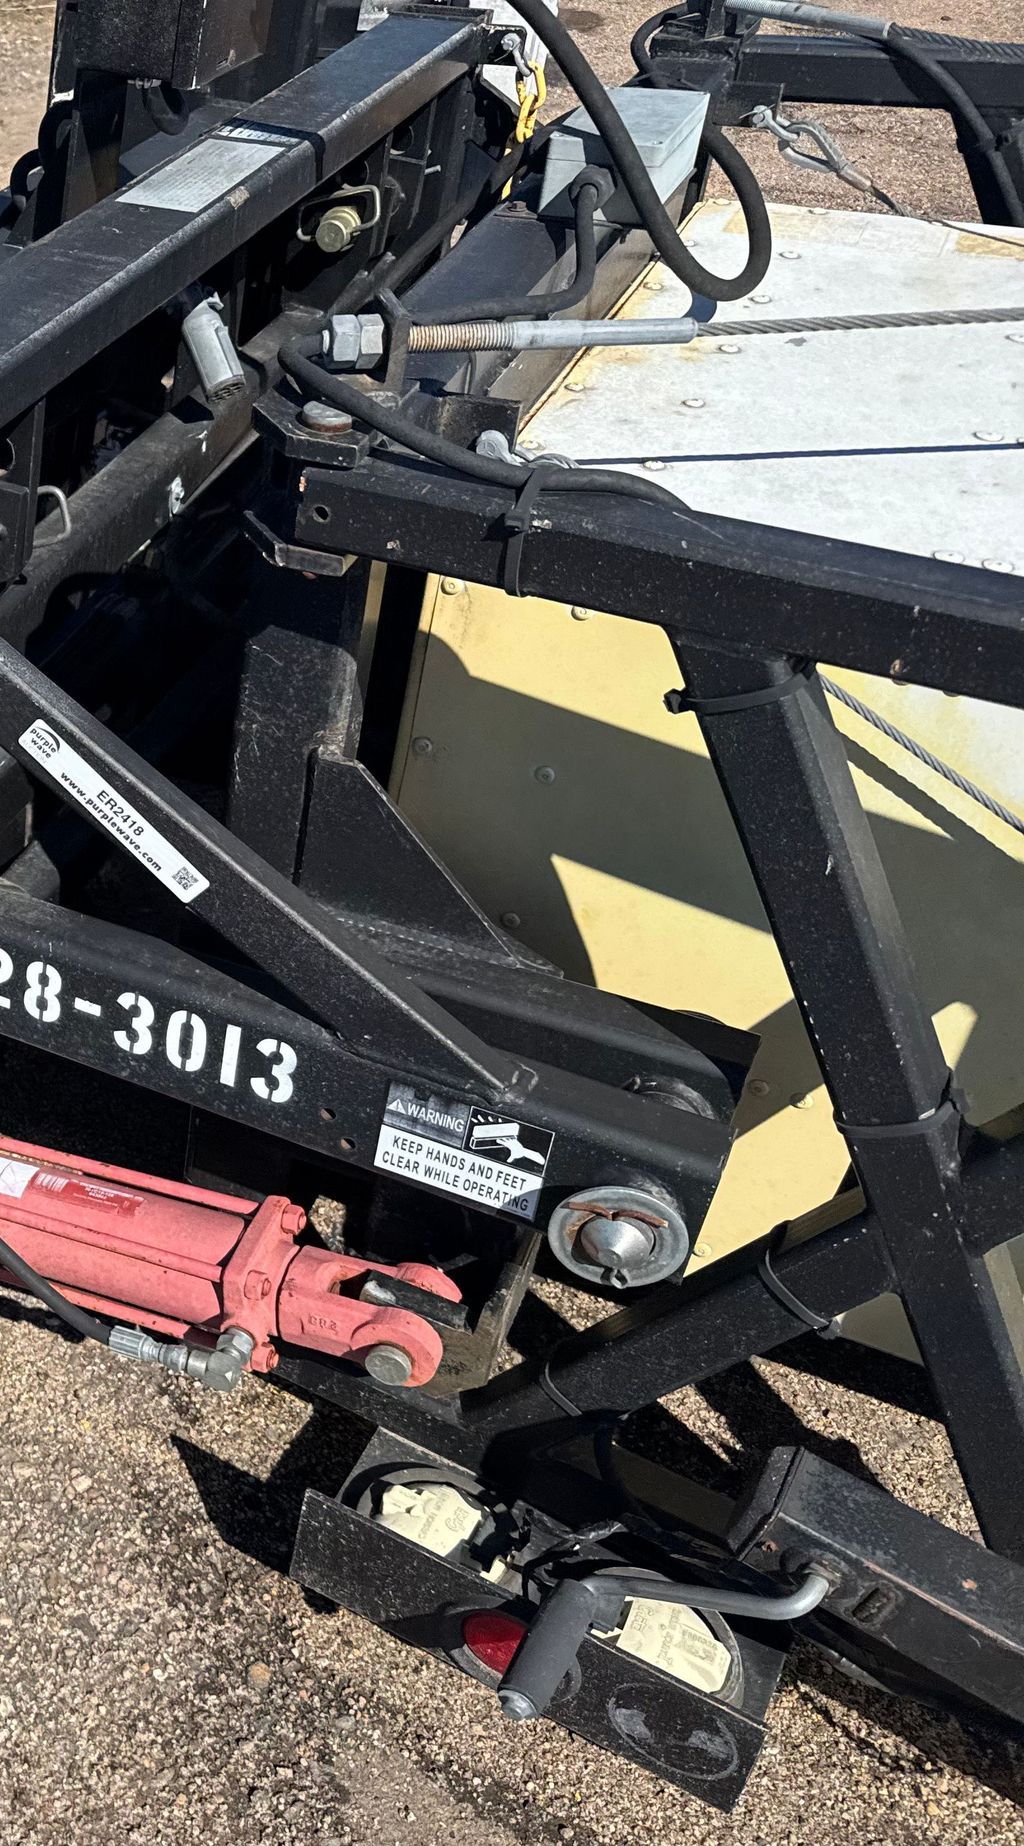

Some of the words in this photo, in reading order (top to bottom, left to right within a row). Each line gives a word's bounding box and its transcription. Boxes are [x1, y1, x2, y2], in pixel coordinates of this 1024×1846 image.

[30, 728, 56, 753] purple
[31, 737, 51, 759] wave
[60, 771, 162, 872] www.purplewave.com
[96, 790, 145, 836] ER2418
[407, 1102, 465, 1133] WARNING
[382, 1151, 420, 1174] CLEAR
[424, 1164, 460, 1188] WHILE
[463, 1179, 529, 1211] OPERATING
[392, 1135, 423, 1155] KEEP
[425, 1146, 466, 1171] HANDS
[468, 1161, 494, 1180] AND
[495, 1171, 527, 1191] FEET
